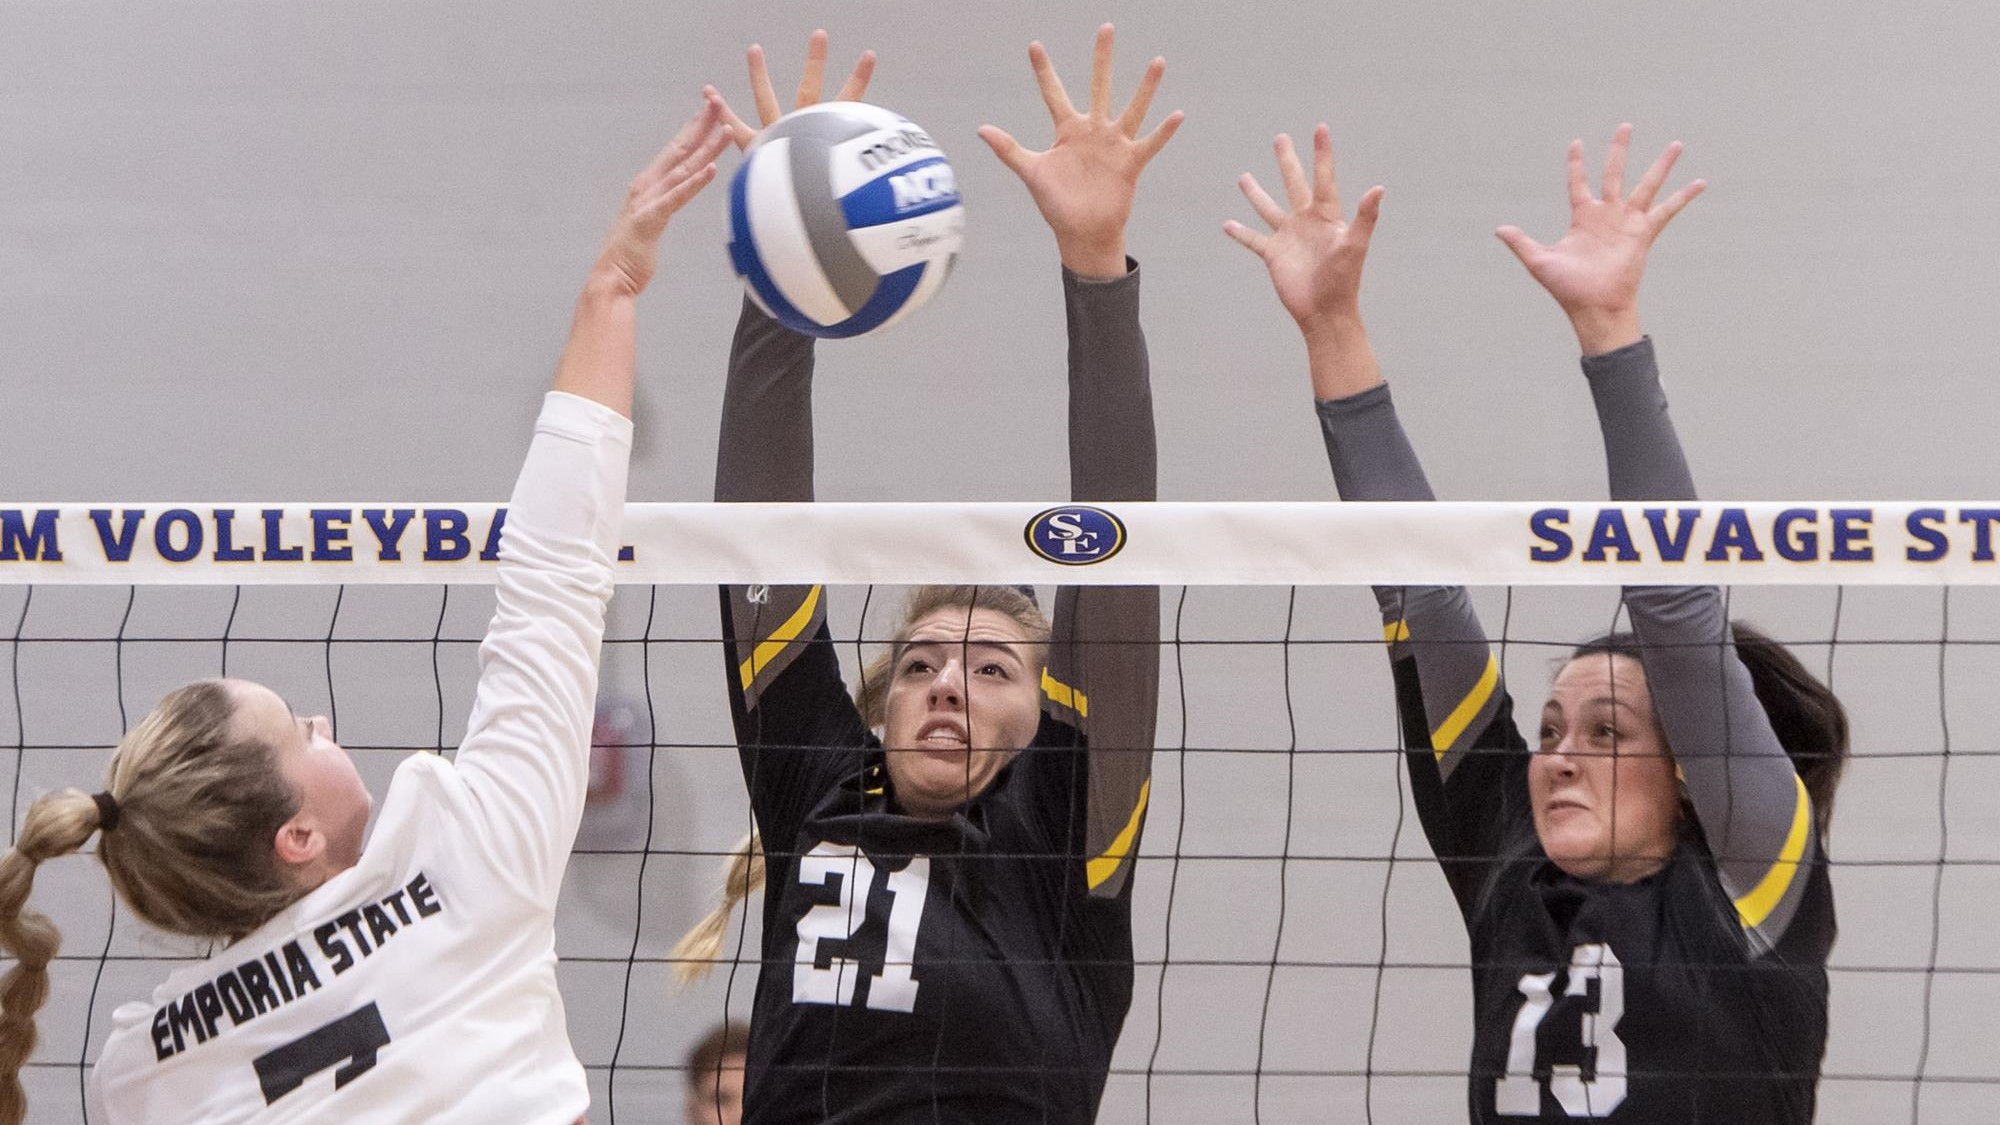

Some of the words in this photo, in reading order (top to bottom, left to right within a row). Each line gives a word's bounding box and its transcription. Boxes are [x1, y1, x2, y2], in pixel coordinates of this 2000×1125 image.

[88, 508, 635, 562] VOLLEYB
[1047, 512, 1101, 555] SE
[1529, 507, 1875, 562] SAVAGE
[1905, 507, 2000, 562] ST
[149, 939, 323, 1063] EMPORIA
[312, 870, 442, 977] STATE
[791, 840, 931, 1014] 21
[1494, 941, 1628, 1118] 13
